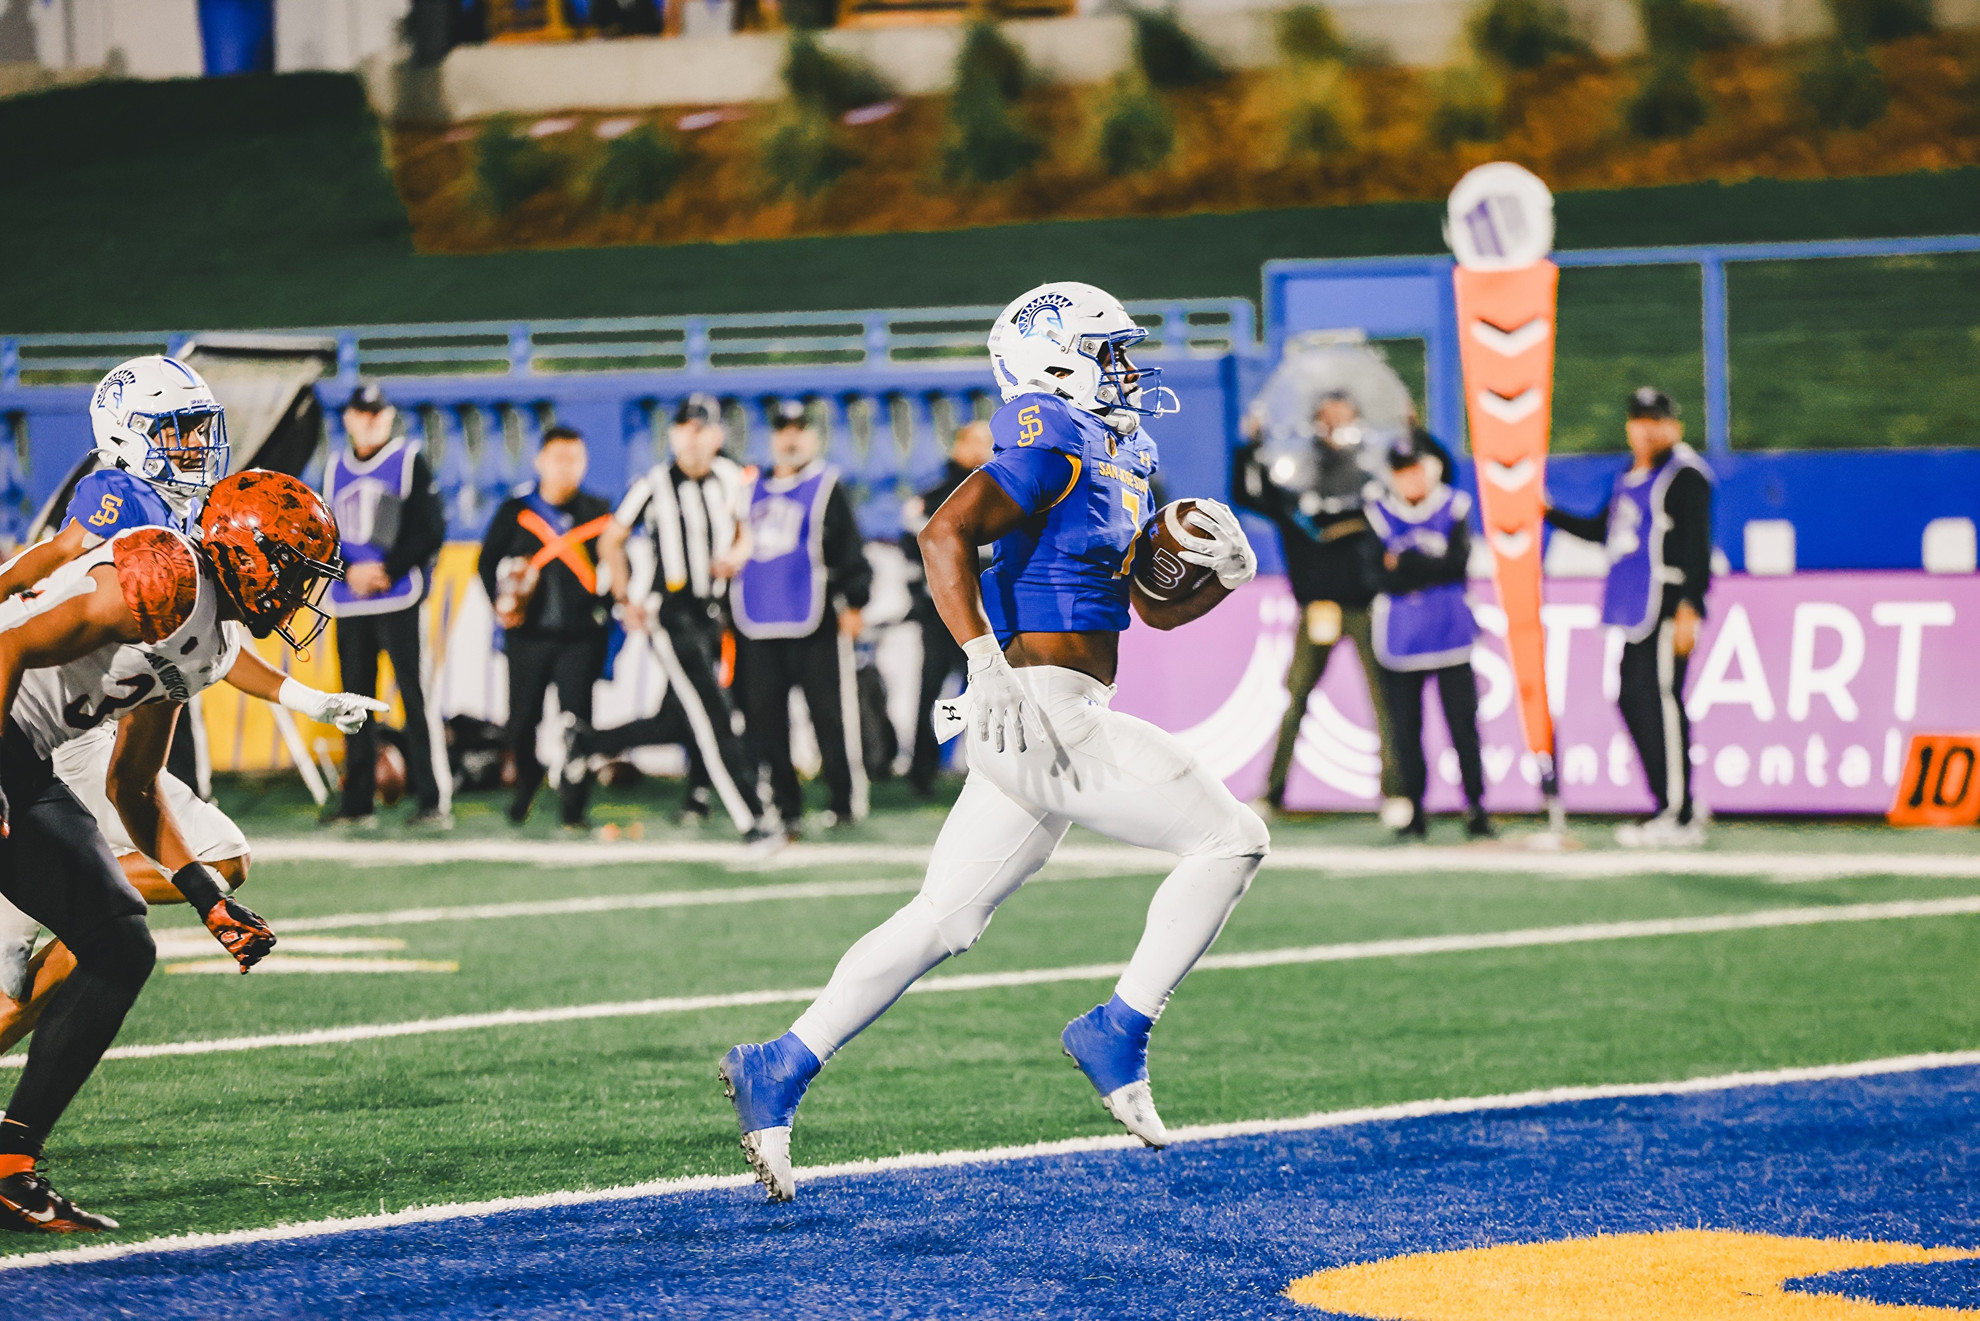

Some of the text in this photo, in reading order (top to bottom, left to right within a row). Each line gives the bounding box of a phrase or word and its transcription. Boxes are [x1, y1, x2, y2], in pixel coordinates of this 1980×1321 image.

[1098, 461, 1119, 480] SAN
[1111, 487, 1142, 580] 7
[1908, 745, 1975, 809] 10
